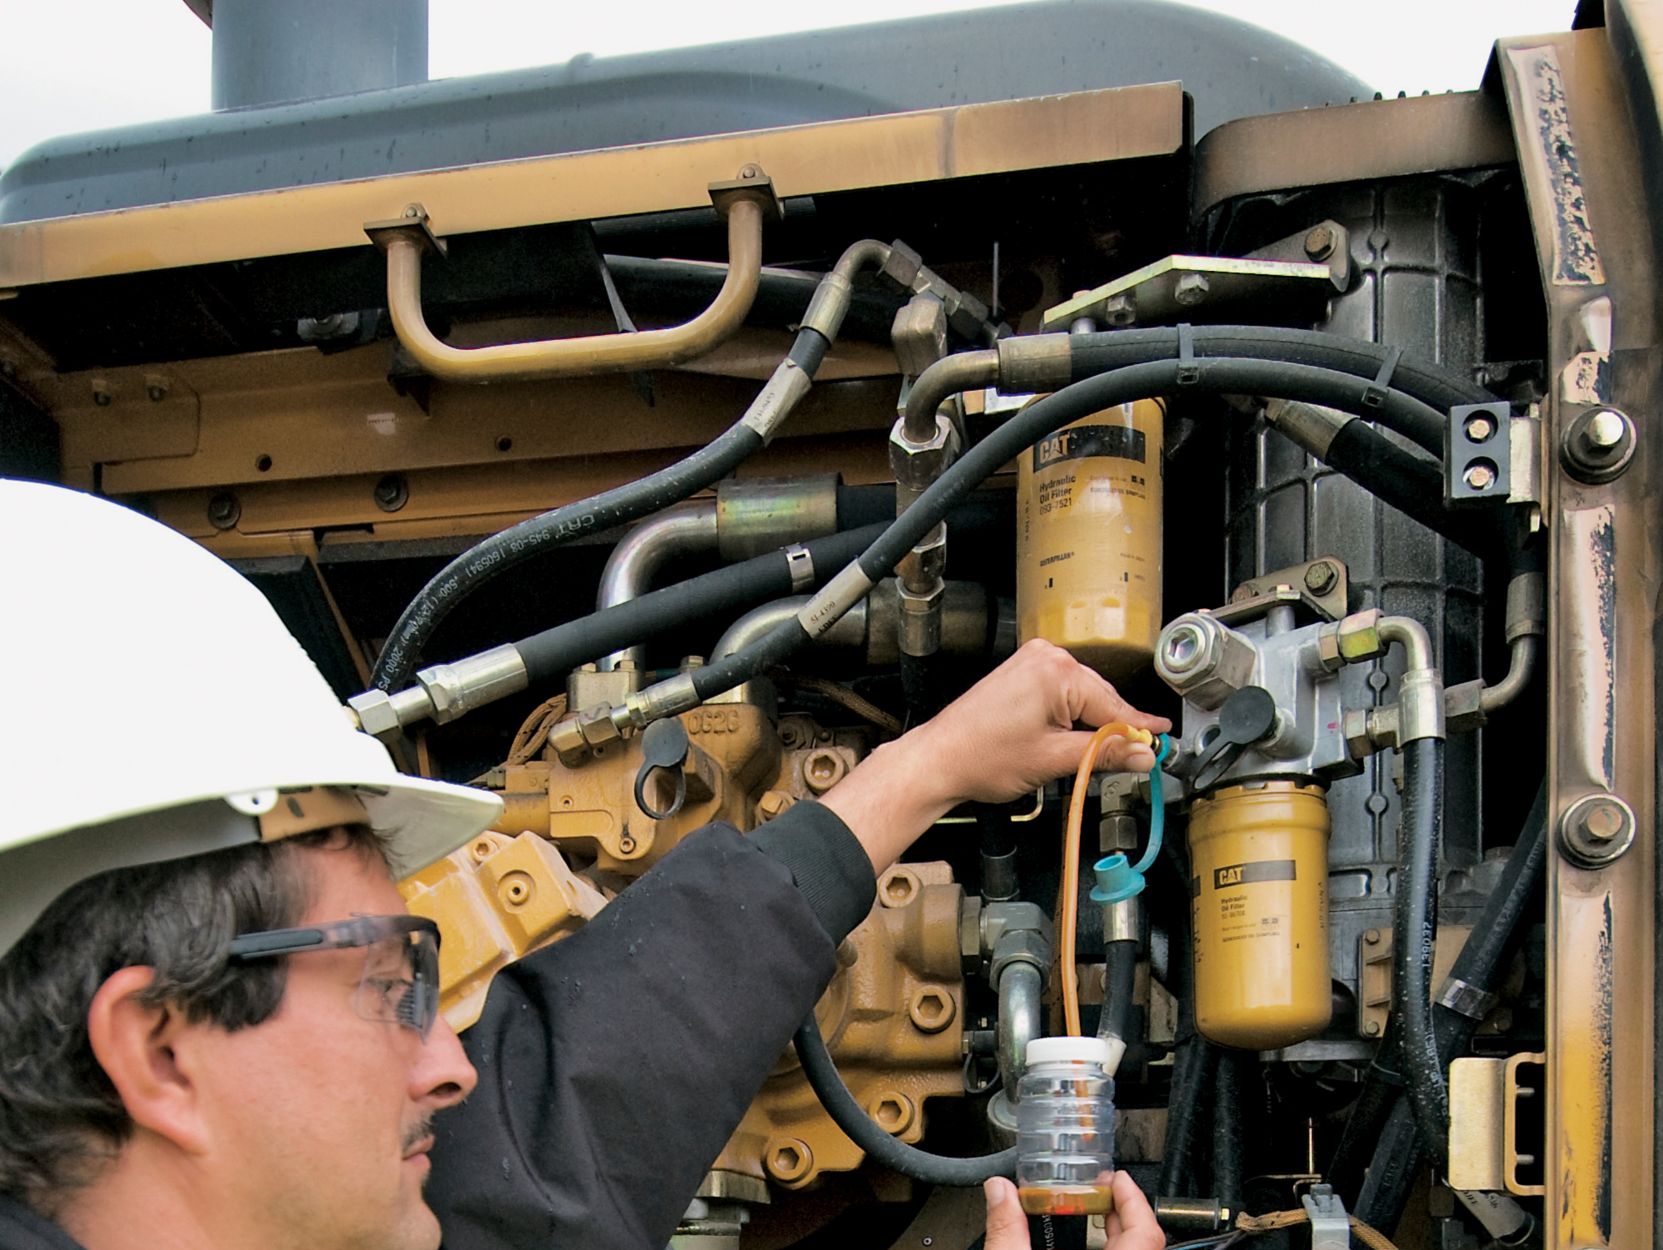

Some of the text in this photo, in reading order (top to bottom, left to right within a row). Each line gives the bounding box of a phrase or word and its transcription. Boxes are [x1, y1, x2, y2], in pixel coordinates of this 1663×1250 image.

[1040, 434, 1070, 464] CAT
[1040, 475, 1076, 492] Hydraulic
[1040, 488, 1072, 504] Oil Filter
[559, 514, 596, 535] CAT
[510, 529, 550, 553] 945-08
[1219, 867, 1243, 885] CAT
